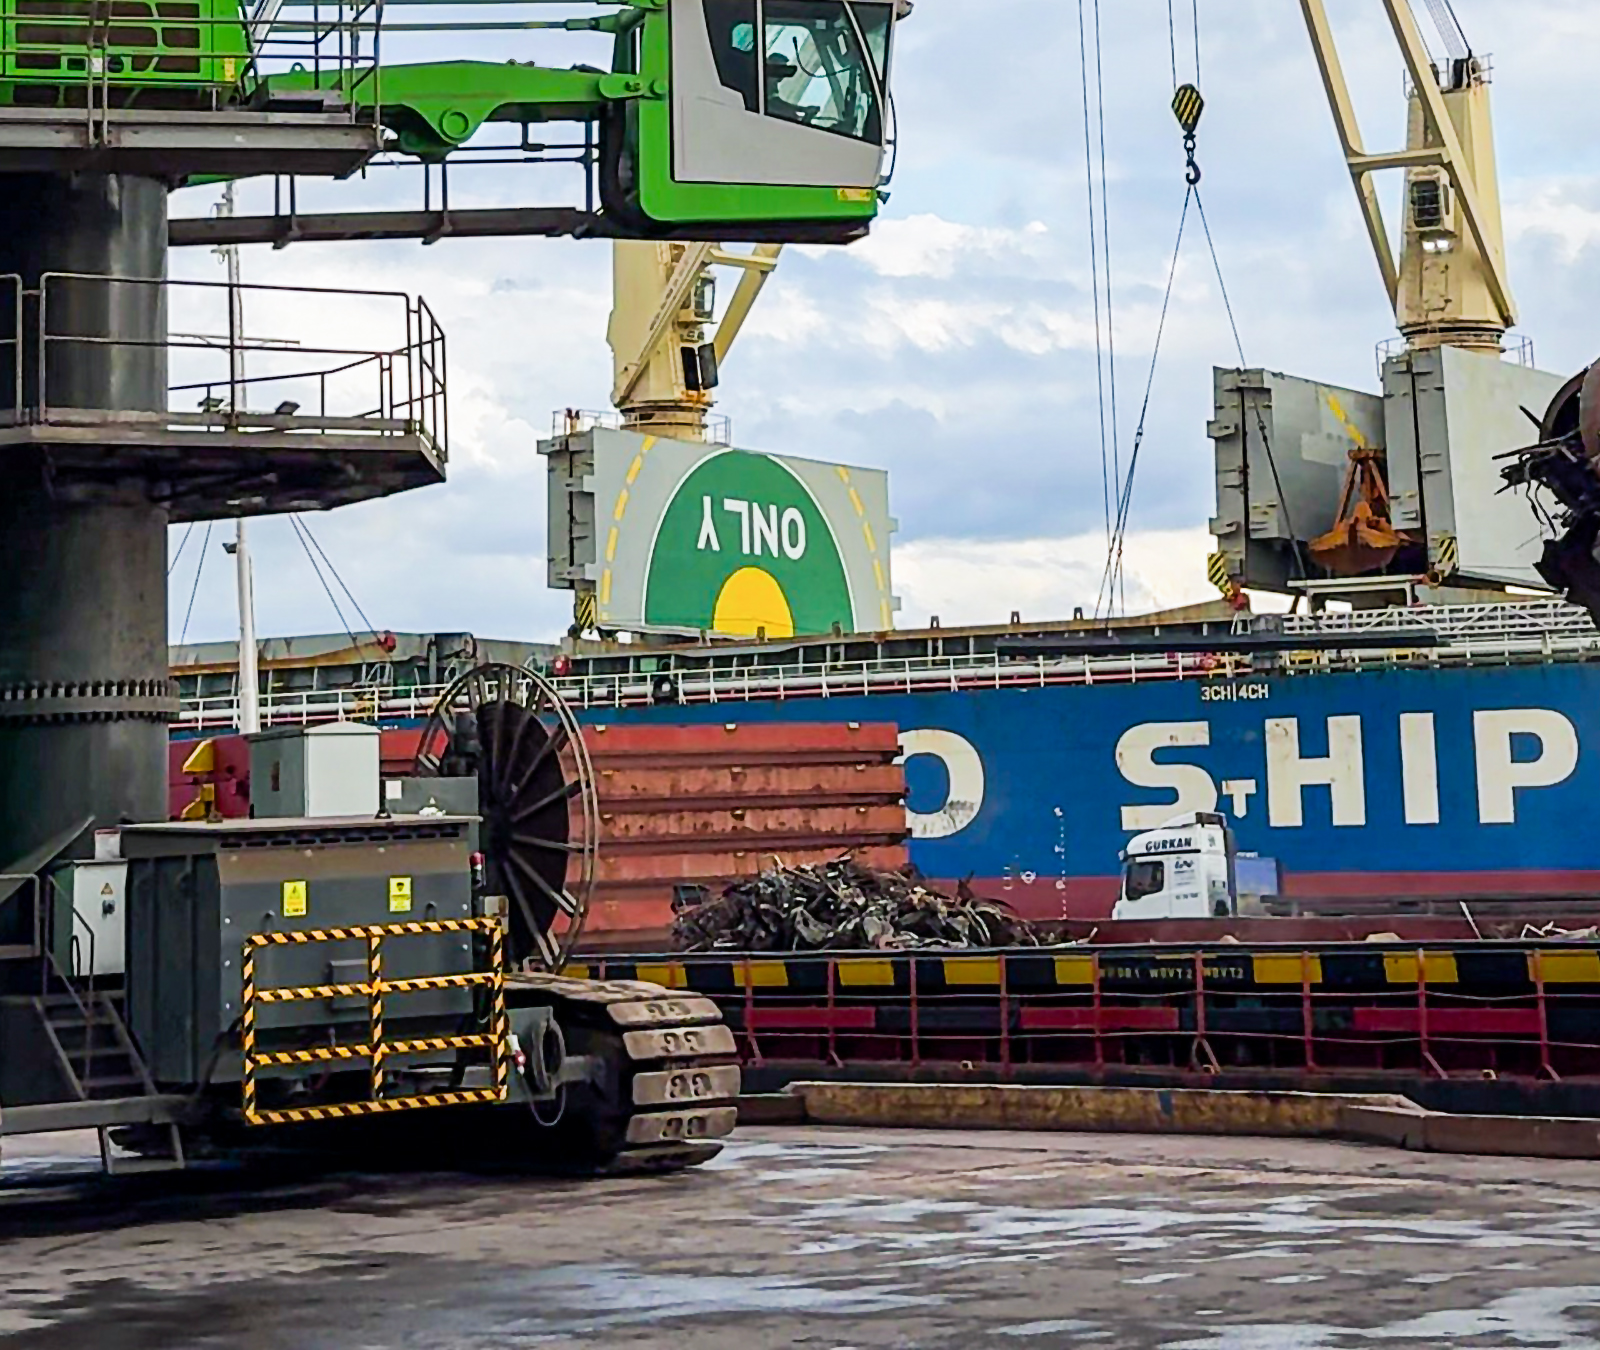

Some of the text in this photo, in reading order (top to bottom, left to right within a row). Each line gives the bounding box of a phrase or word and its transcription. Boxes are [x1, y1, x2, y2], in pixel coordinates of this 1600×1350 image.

[697, 495, 806, 560] ONLY
[1221, 779, 1257, 819] T
[1145, 837, 1193, 852] GURKAN
